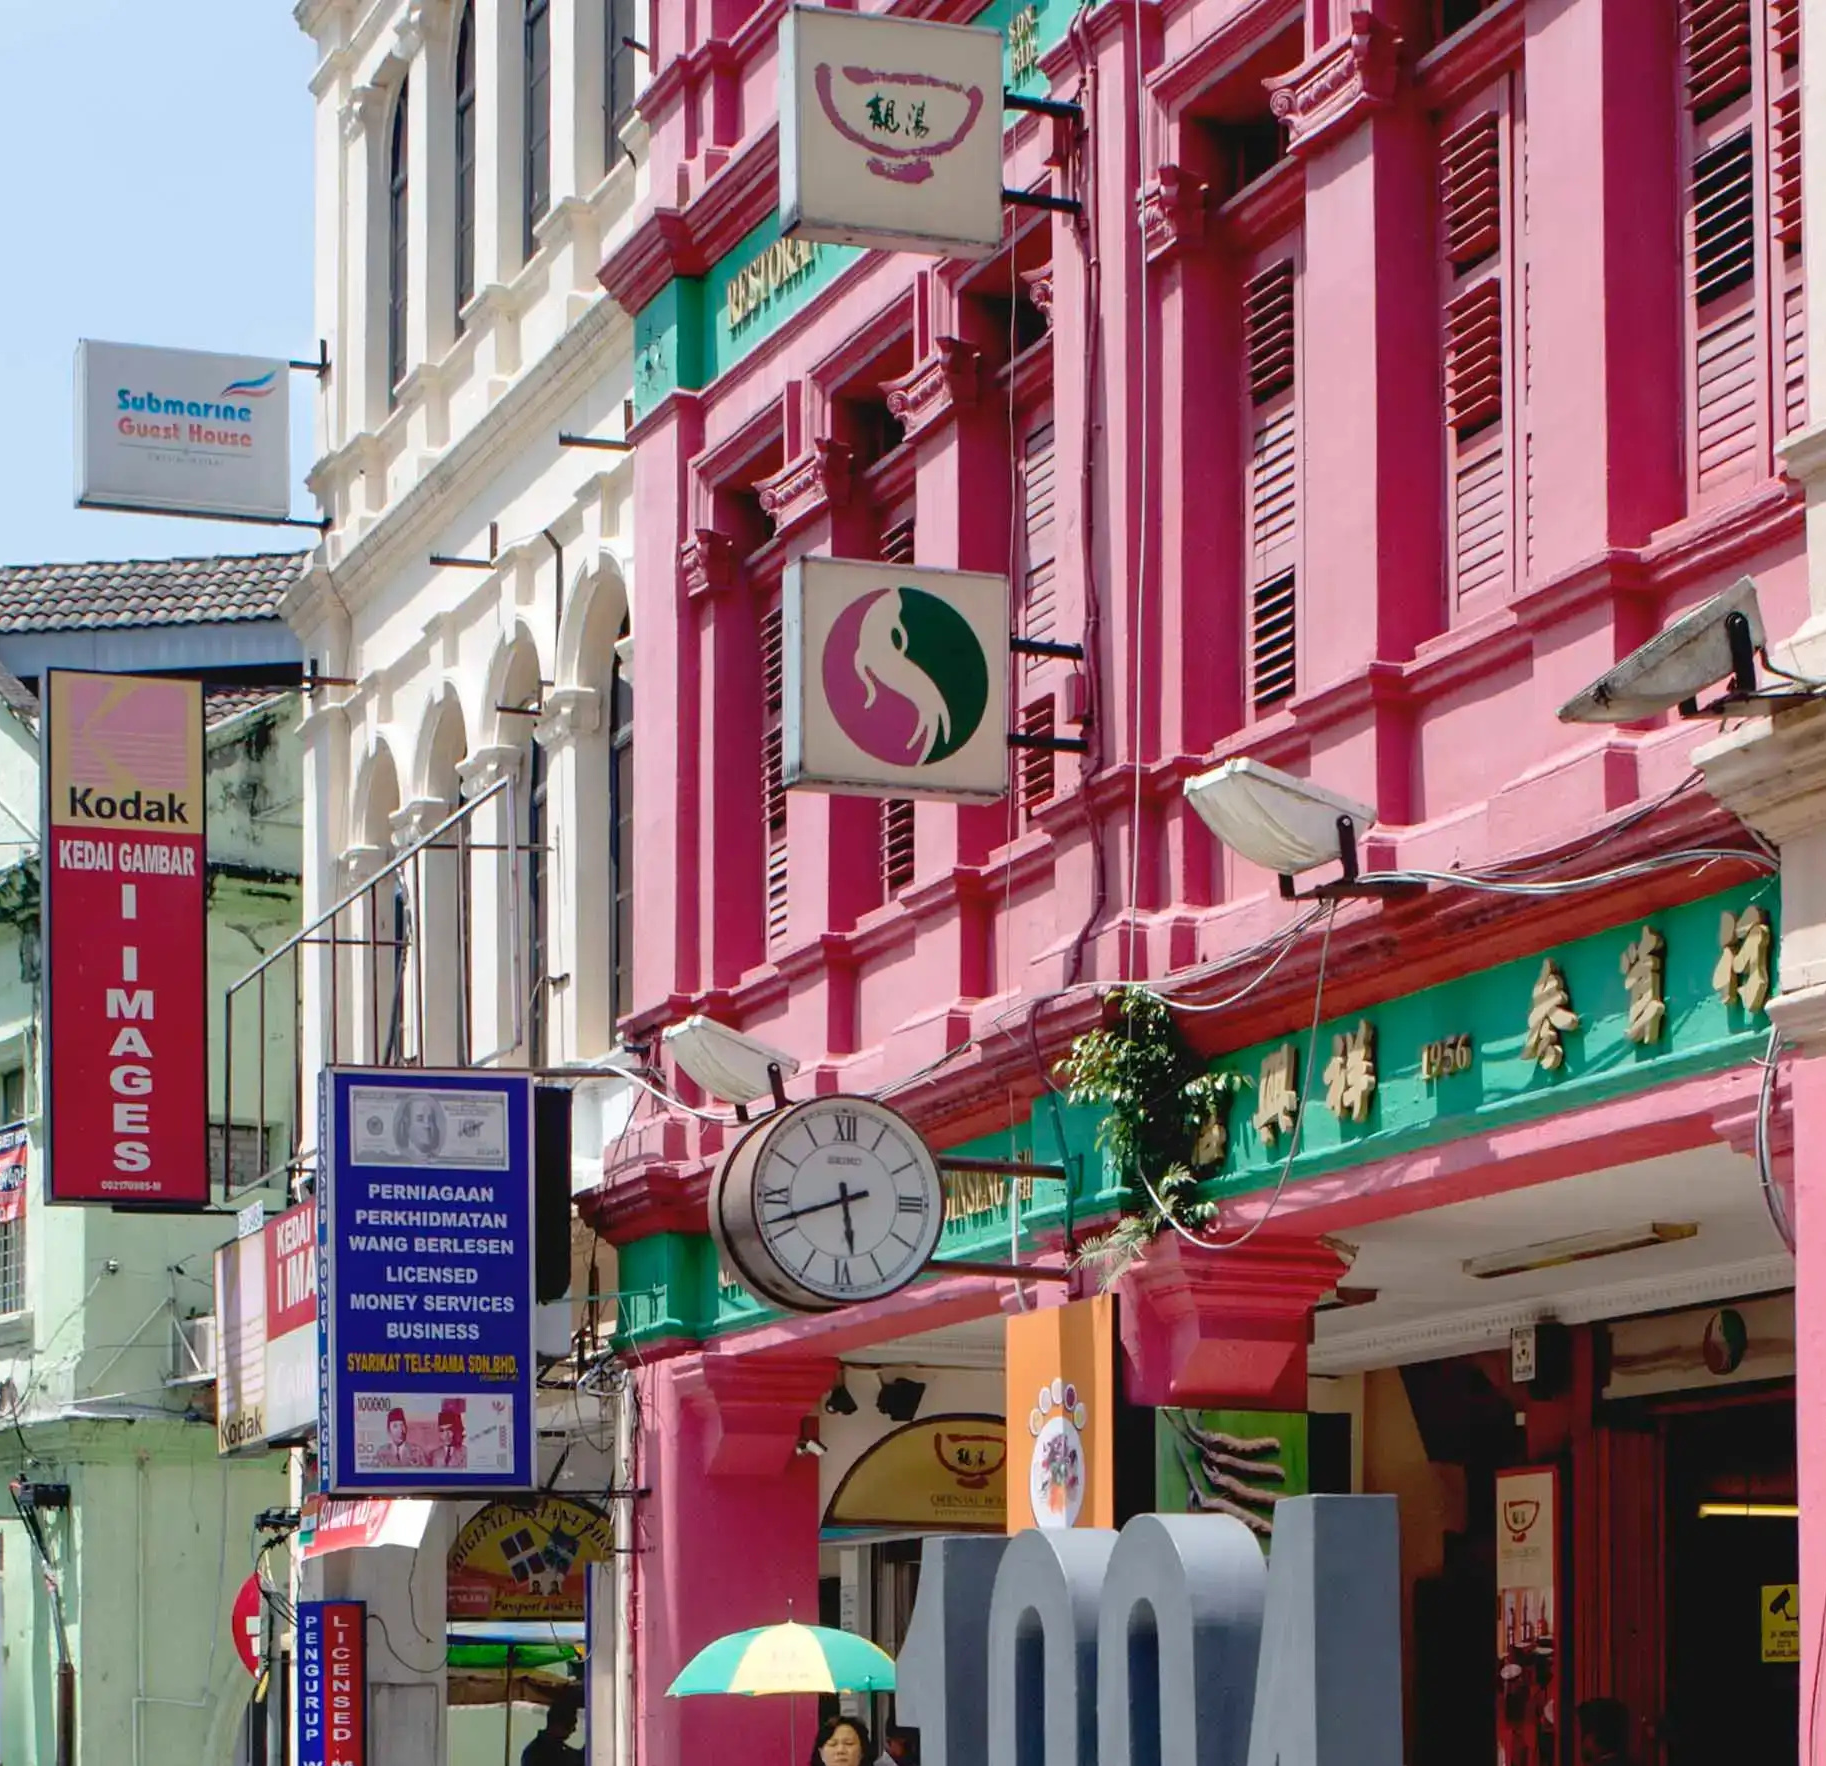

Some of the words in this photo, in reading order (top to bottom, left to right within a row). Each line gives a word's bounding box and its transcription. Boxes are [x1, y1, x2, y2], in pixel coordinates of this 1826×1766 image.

[117, 388, 252, 422] Submarine
[118, 416, 181, 440] Guest
[189, 423, 253, 448] House
[70, 786, 189, 824] Kodak
[59, 839, 114, 871] KEDAI
[118, 843, 195, 876] GAMBAR
[1421, 1033, 1472, 1081] 1956
[368, 1183, 495, 1203] PERNIAGAAN
[275, 1207, 312, 1259] KEDAI
[355, 1209, 508, 1228] PERKHIDMATAN
[349, 1235, 408, 1252] WANG
[414, 1237, 514, 1255] BERLESEN
[386, 1266, 479, 1284] LICENSED
[350, 1294, 418, 1311] MONEY
[423, 1295, 515, 1312] SERVICES
[386, 1322, 480, 1340] BUSINESS
[347, 1352, 401, 1372] SYARIKAT
[220, 1407, 264, 1450] Kodak
[305, 1616, 319, 1742] PENGURUP
[332, 1616, 352, 1741] LICENSED
